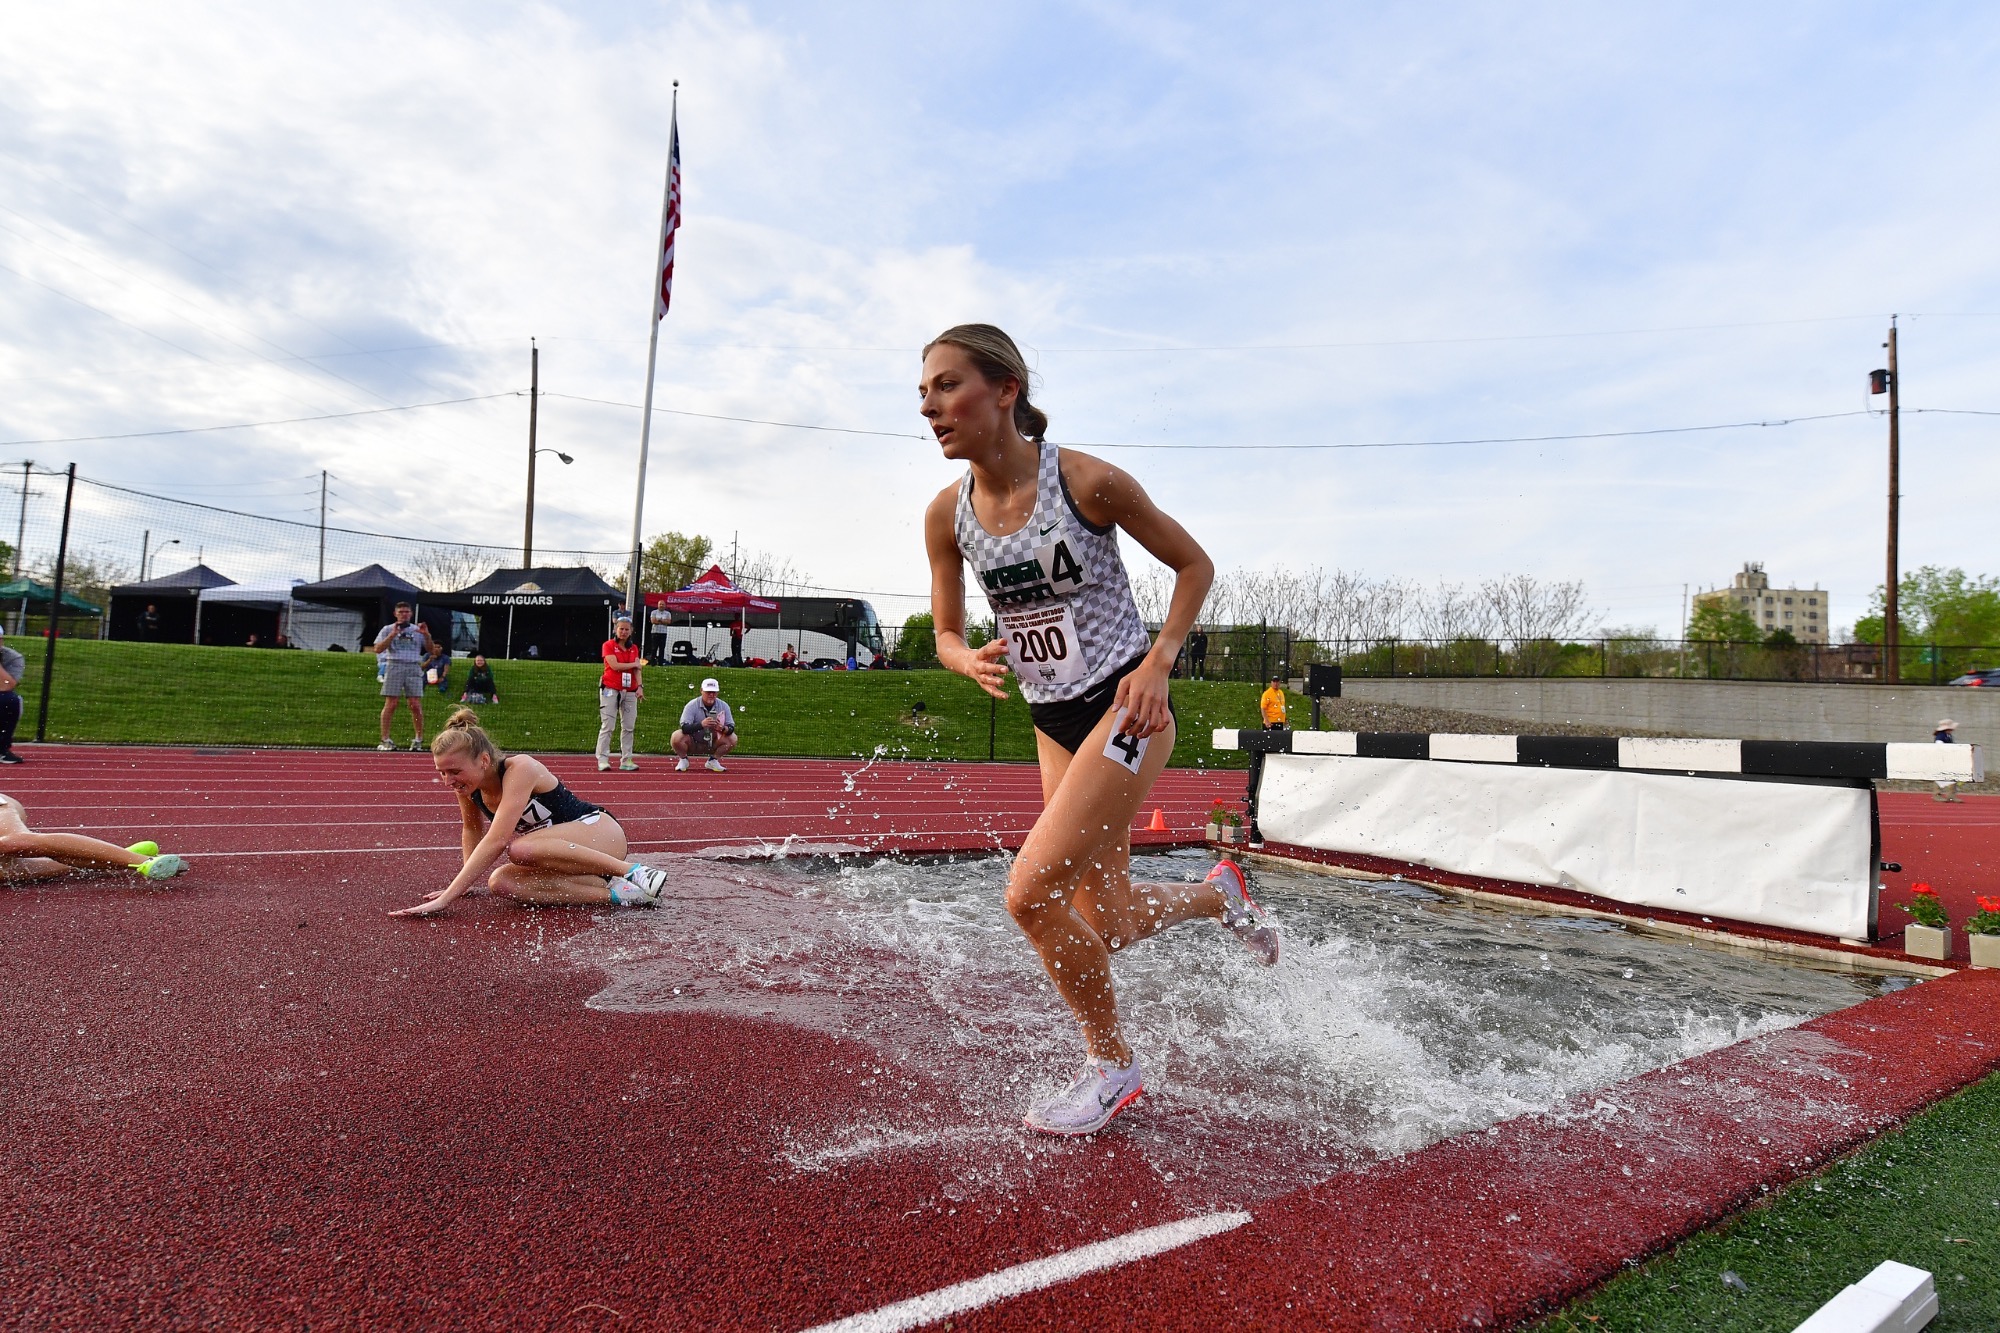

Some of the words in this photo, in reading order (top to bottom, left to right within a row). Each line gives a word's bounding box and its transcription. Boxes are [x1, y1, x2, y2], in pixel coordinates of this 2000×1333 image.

[980, 558, 1046, 591] WRIGH
[1052, 539, 1084, 586] 4
[472, 595, 500, 604] IUPUI
[501, 596, 553, 605] JAGUARS
[1041, 607, 1066, 618] OUTDOOR
[1012, 625, 1068, 662] 200
[1112, 716, 1144, 766] 4
